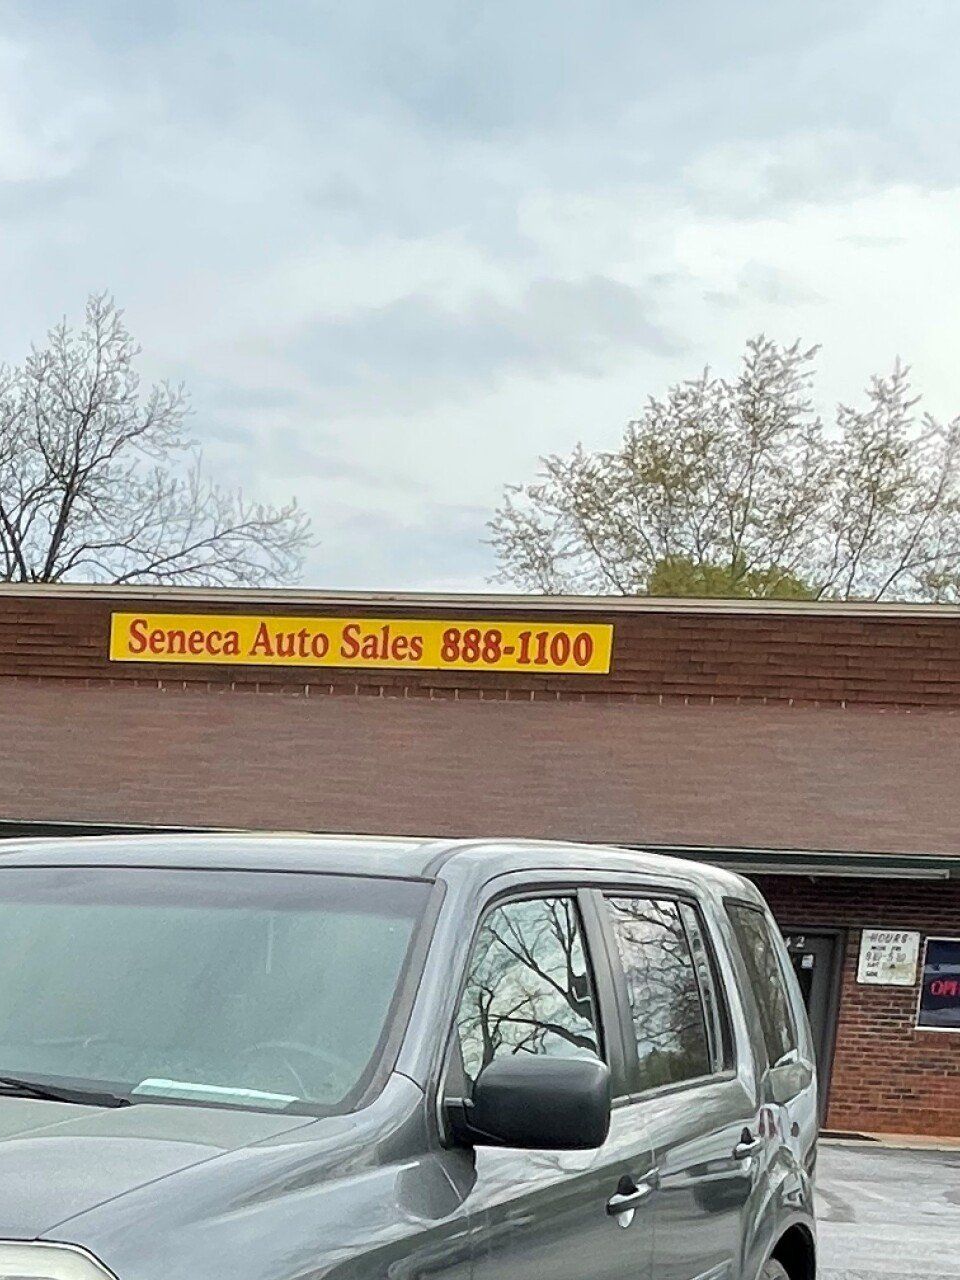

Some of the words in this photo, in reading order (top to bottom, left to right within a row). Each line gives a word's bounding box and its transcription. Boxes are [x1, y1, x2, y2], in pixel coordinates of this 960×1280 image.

[128, 618, 241, 655] Seneca
[248, 621, 329, 658] Auto
[340, 623, 423, 661] Sales
[440, 627, 593, 667] 888-1100
